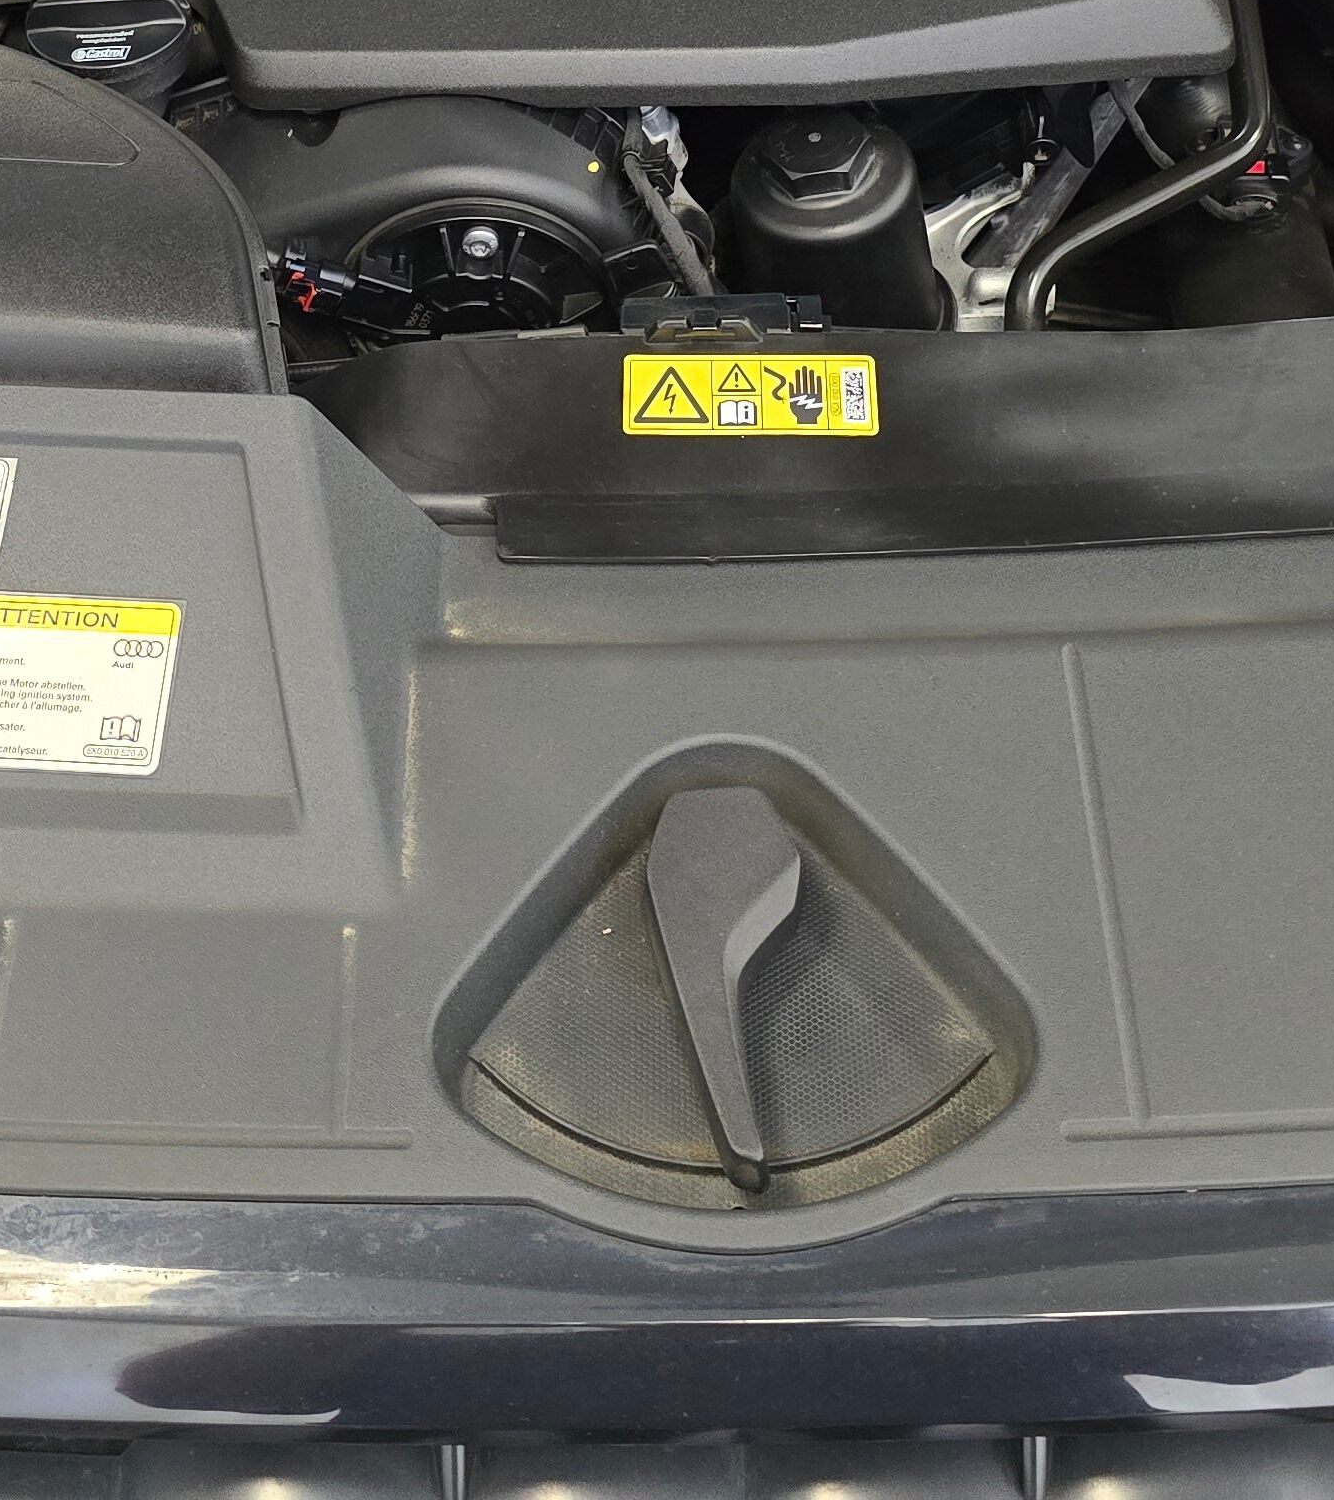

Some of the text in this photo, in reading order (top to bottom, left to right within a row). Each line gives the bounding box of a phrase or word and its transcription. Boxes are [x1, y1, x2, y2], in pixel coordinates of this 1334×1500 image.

[86, 48, 125, 59] Castrol
[112, 661, 134, 669] Audi
[10, 678, 39, 688] Motor
[18, 691, 54, 700] ignition
